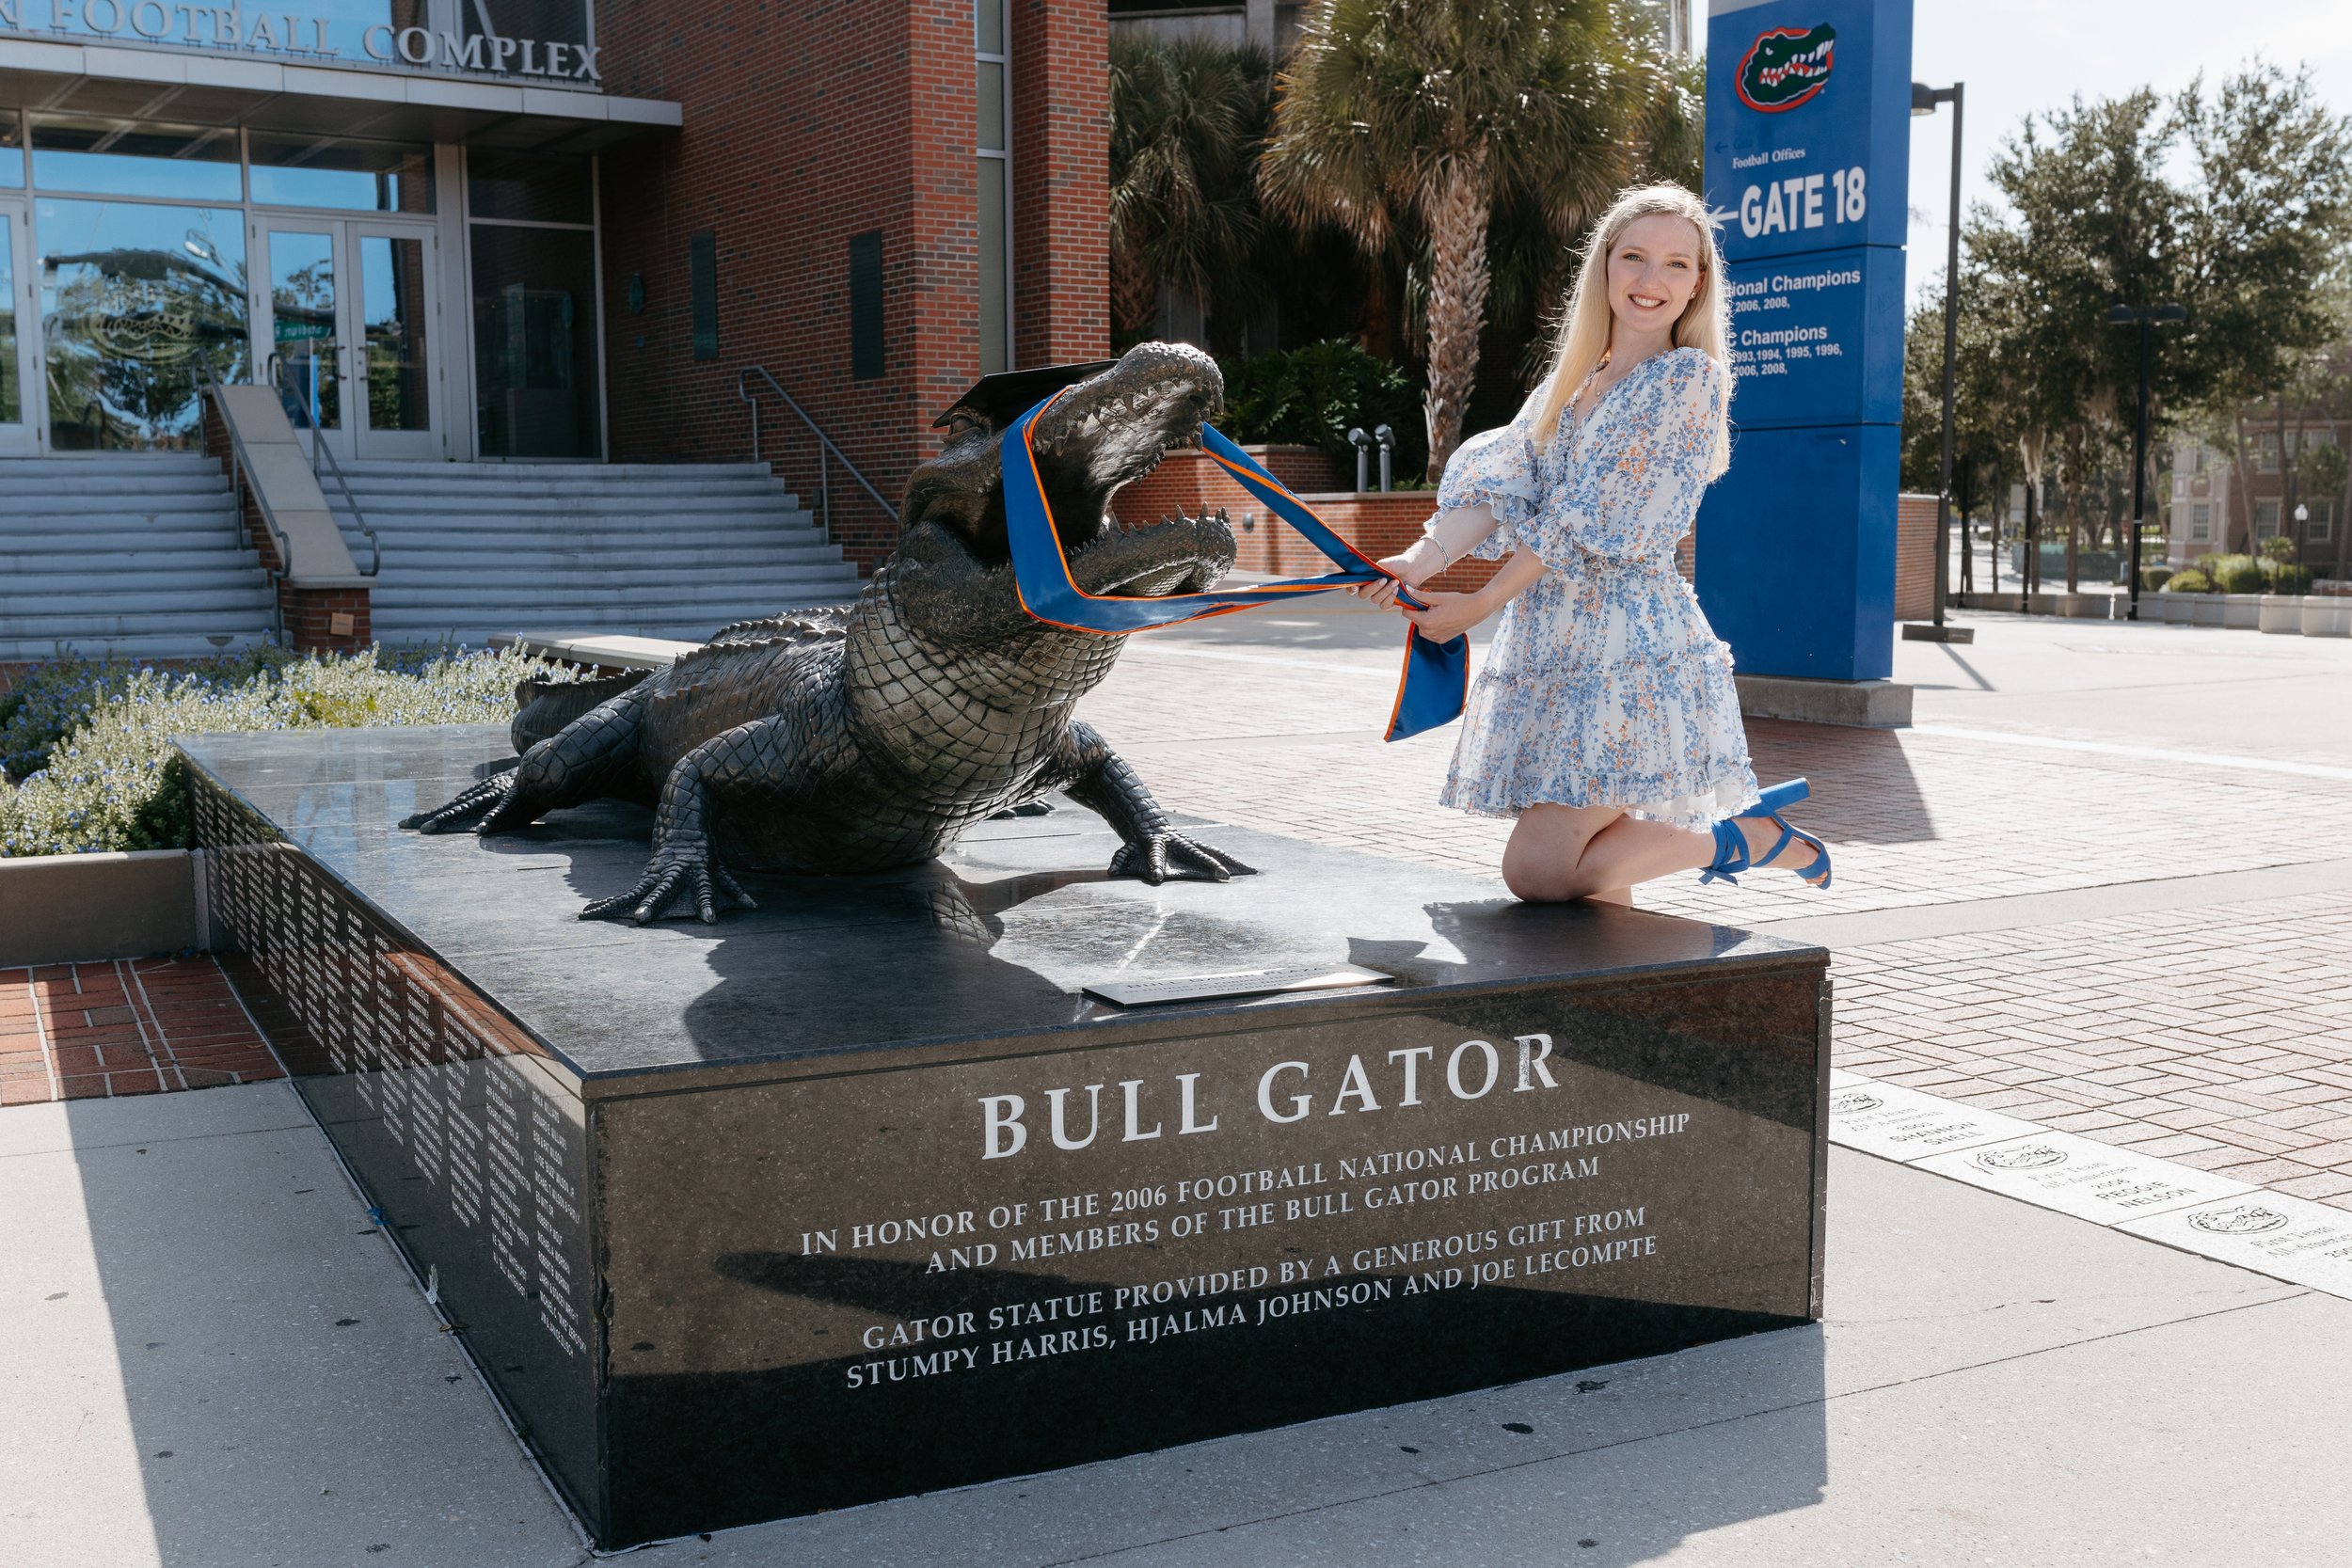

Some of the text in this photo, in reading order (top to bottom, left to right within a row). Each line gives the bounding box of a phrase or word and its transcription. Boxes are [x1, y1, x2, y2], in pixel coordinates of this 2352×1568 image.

[50, 0, 339, 55] FOOTBALL
[363, 24, 602, 81] COMPLEX
[1732, 148, 1805, 169] Football Offices
[1741, 166, 1867, 239] GATE 18
[1729, 270, 1861, 297] ional Champions
[1736, 296, 1790, 312] 2006, 2008,
[1741, 325, 1827, 346] Champions
[1786, 345, 1812, 358] 1995,
[1815, 343, 1843, 356] 1996,
[1761, 363, 1788, 375] 2008,
[977, 1034, 1559, 1160] BULL GATOR
[1889, 1121, 1979, 1142] SHANNON
[1923, 1131, 1985, 1145] SNELL
[801, 1113, 1691, 1256] IN HONOR OF THE 2006 FOOTBALL NATIONAL CHAMPIONSHIP
[2095, 1181, 2170, 1201] REGGIE
[2116, 1187, 2198, 1209] NELSON
[926, 1156, 1599, 1275] AND MEMBERS OF THE BULL GATOR PROGRAM
[863, 1207, 1645, 1350] GATOR STATUE PROVIDED BY A GENEROUS GIFT FROM
[847, 1235, 1658, 1389] STUMPY HARRIS, HJALMA JOHNSON AND JOE LECOMPTE
